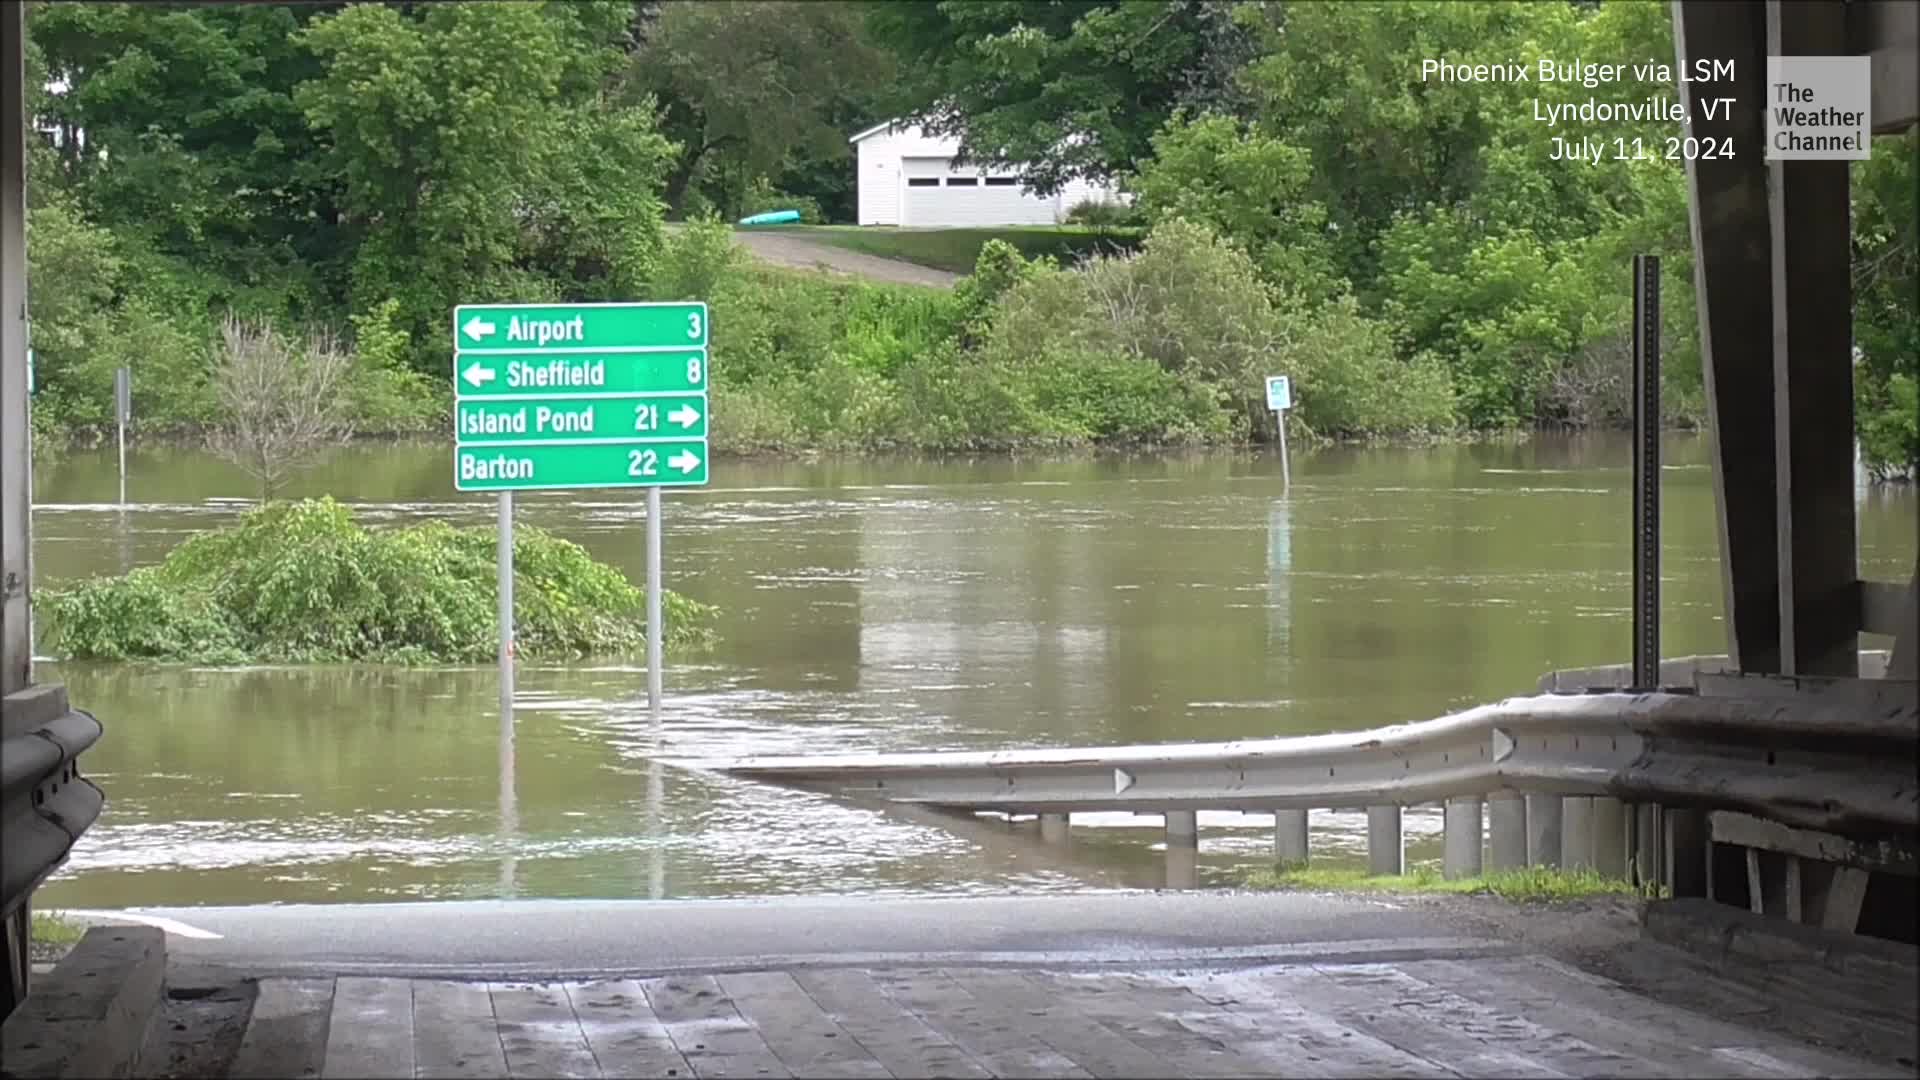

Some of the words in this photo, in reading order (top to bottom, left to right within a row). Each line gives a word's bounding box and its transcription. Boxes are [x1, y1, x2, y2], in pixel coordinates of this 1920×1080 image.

[506, 314, 584, 346] Airport
[686, 312, 701, 338] 3
[506, 359, 605, 387] Sheffield
[686, 357, 702, 384] 8
[461, 407, 526, 434] Island
[536, 405, 594, 432] Pond
[634, 403, 658, 430] 21
[461, 453, 534, 480] Barton
[628, 449, 657, 476] 22
